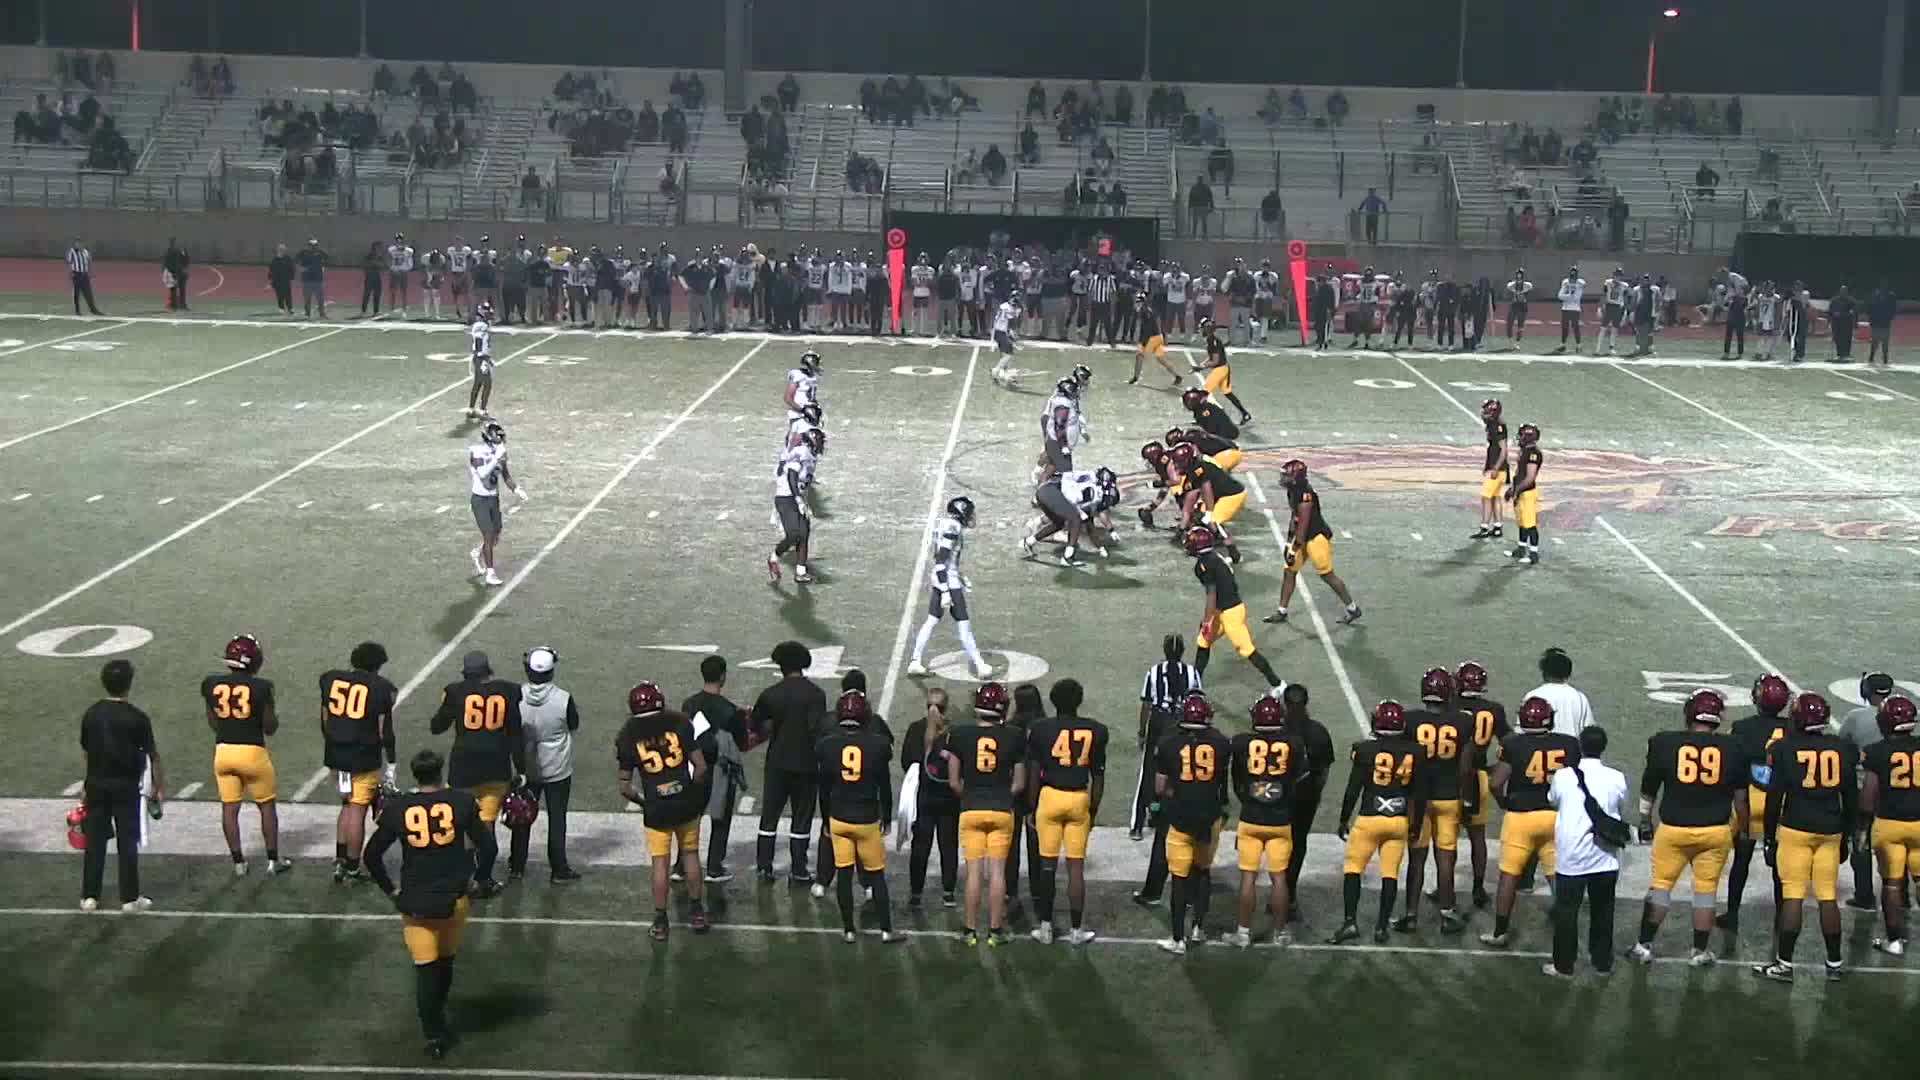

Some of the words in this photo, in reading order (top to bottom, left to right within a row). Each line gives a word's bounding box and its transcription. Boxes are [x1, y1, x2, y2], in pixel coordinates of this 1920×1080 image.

[16, 624, 154, 657] 0
[212, 683, 251, 719] 33
[328, 679, 369, 720] 50
[463, 694, 506, 730] 60
[636, 731, 683, 773] 53
[841, 745, 862, 782] 9
[976, 736, 997, 772] 6
[1051, 729, 1093, 766] 47
[1180, 743, 1215, 781] 19
[1247, 739, 1290, 776] 83
[1677, 745, 1721, 785] 69
[1796, 750, 1841, 788] 70
[404, 802, 455, 848] 93
